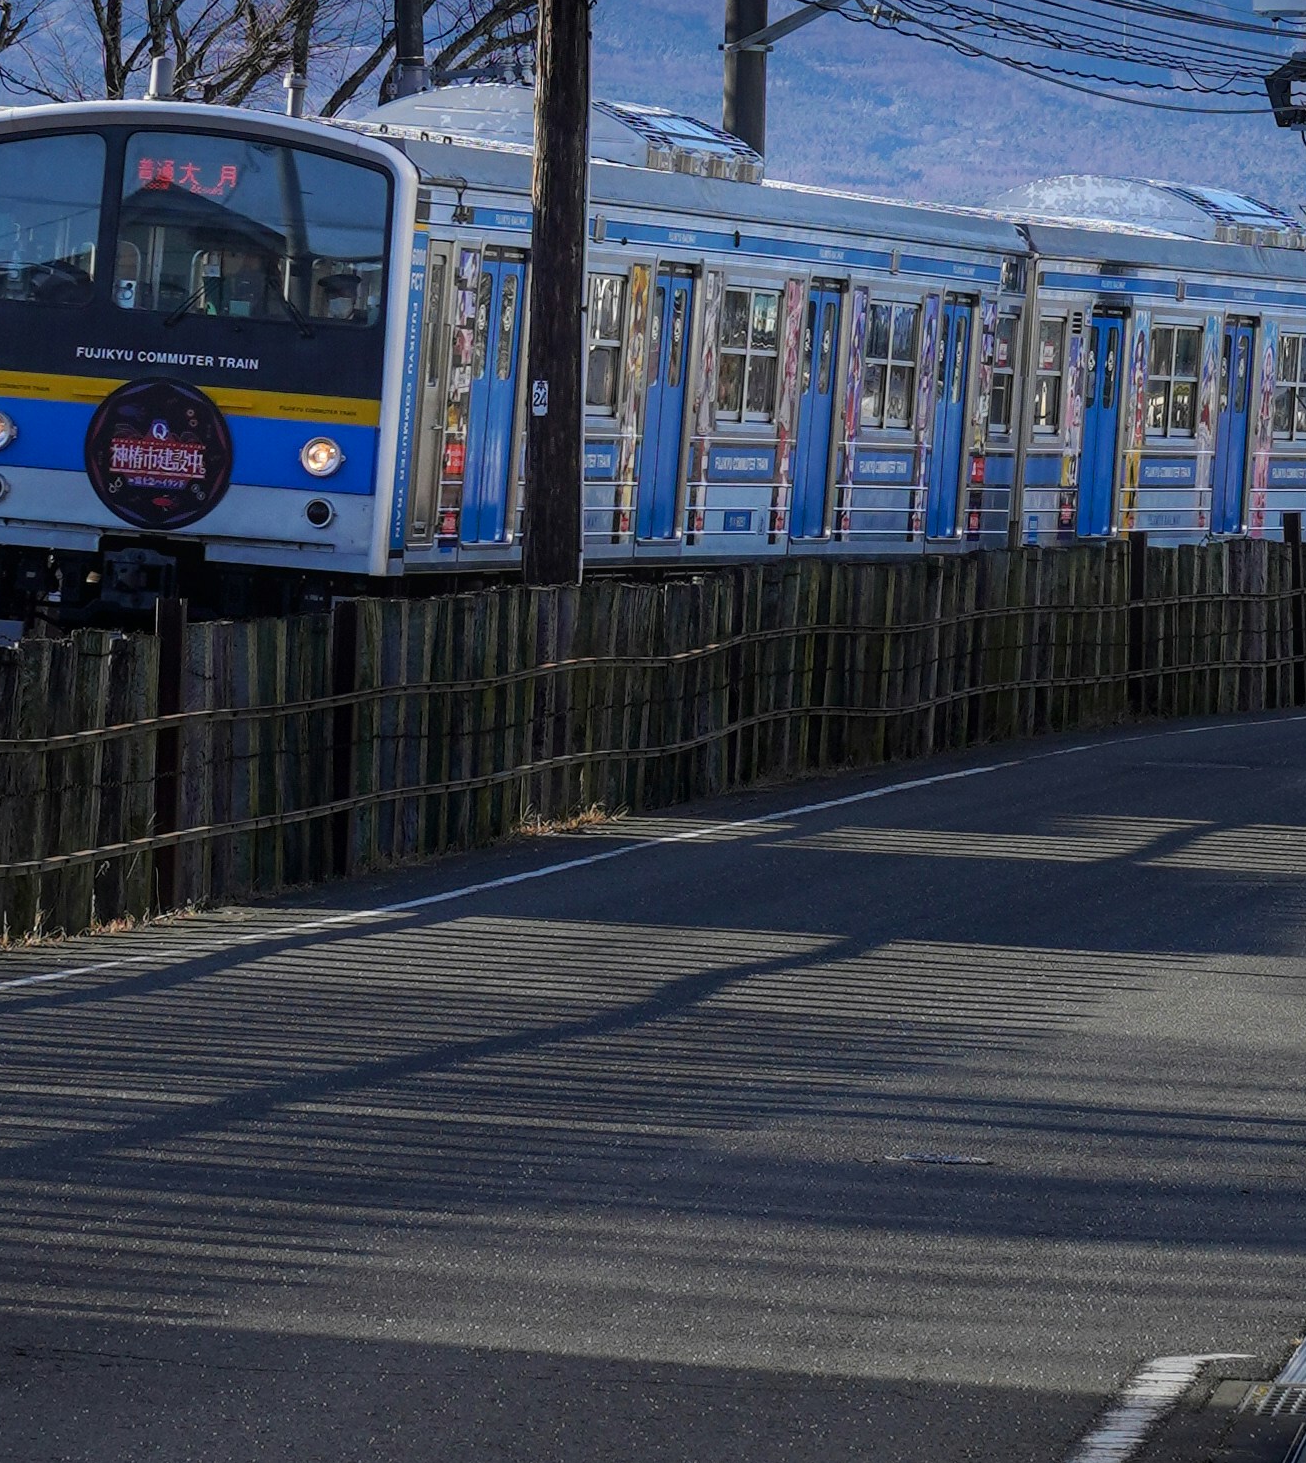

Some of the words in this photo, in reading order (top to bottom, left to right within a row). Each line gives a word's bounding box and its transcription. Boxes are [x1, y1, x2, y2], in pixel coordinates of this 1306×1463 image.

[76, 346, 133, 362] FUJIKYU
[137, 351, 214, 367] COMMUTER
[218, 356, 259, 370] TRAIN
[533, 392, 547, 408] 24
